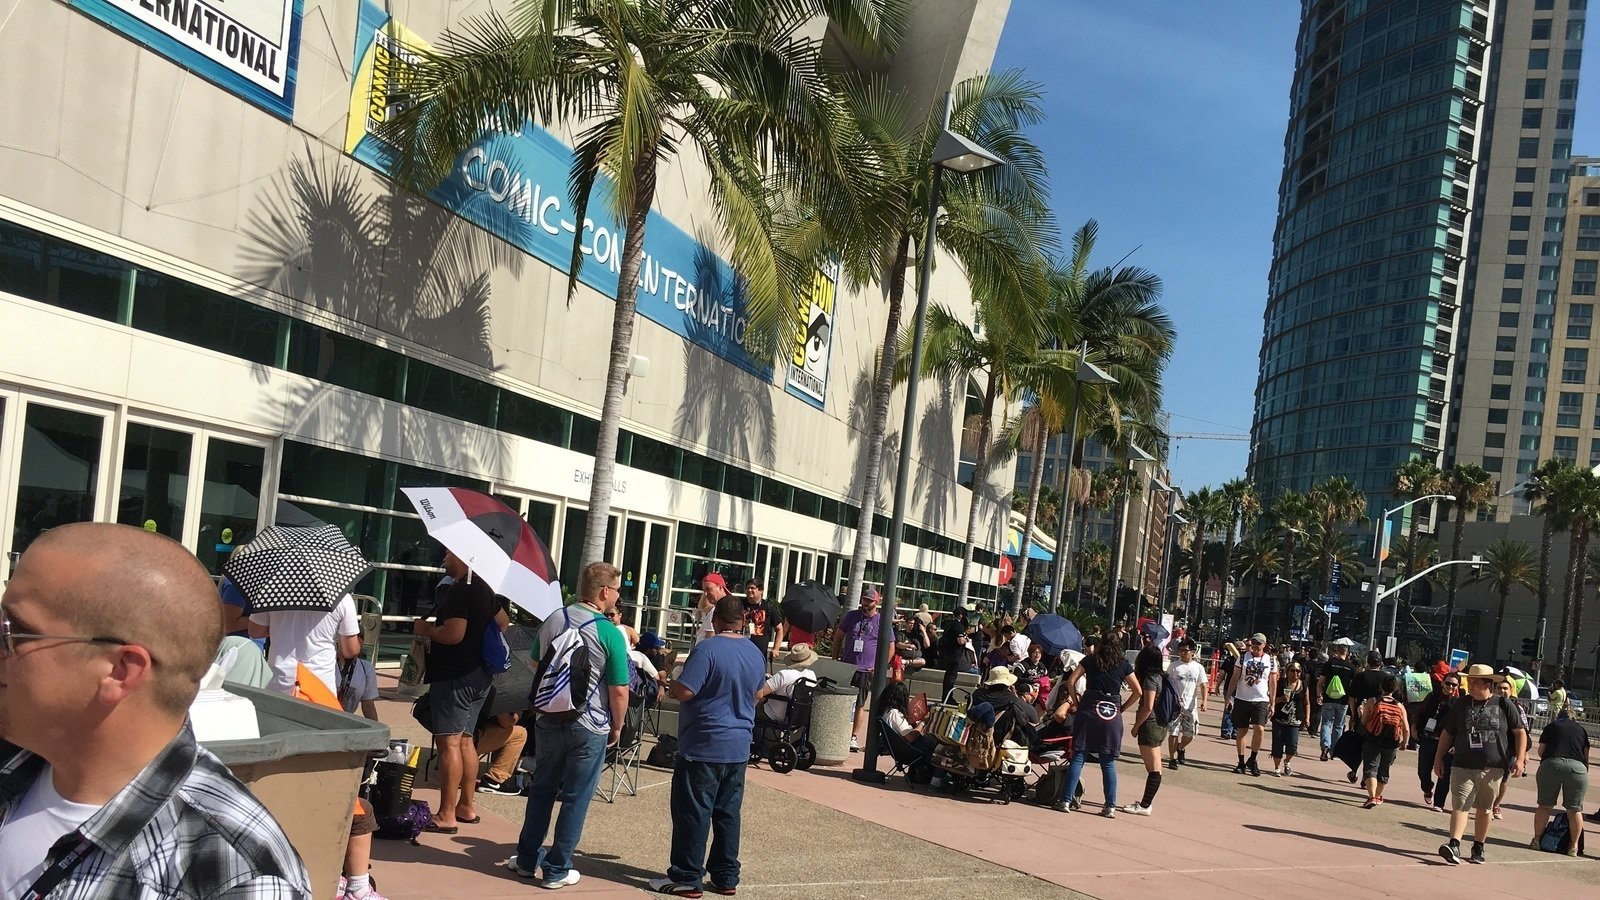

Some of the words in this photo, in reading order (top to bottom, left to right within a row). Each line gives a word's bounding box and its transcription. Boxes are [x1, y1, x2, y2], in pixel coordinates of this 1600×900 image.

[133, 0, 280, 84] RNATIONAL
[370, 46, 390, 123] COMIC
[638, 250, 766, 354] NTERNATIO
[812, 270, 834, 315] CON
[790, 368, 823, 397] INTERNATIONAL
[574, 469, 593, 485] EXHI
[419, 498, 436, 520] Wilson
